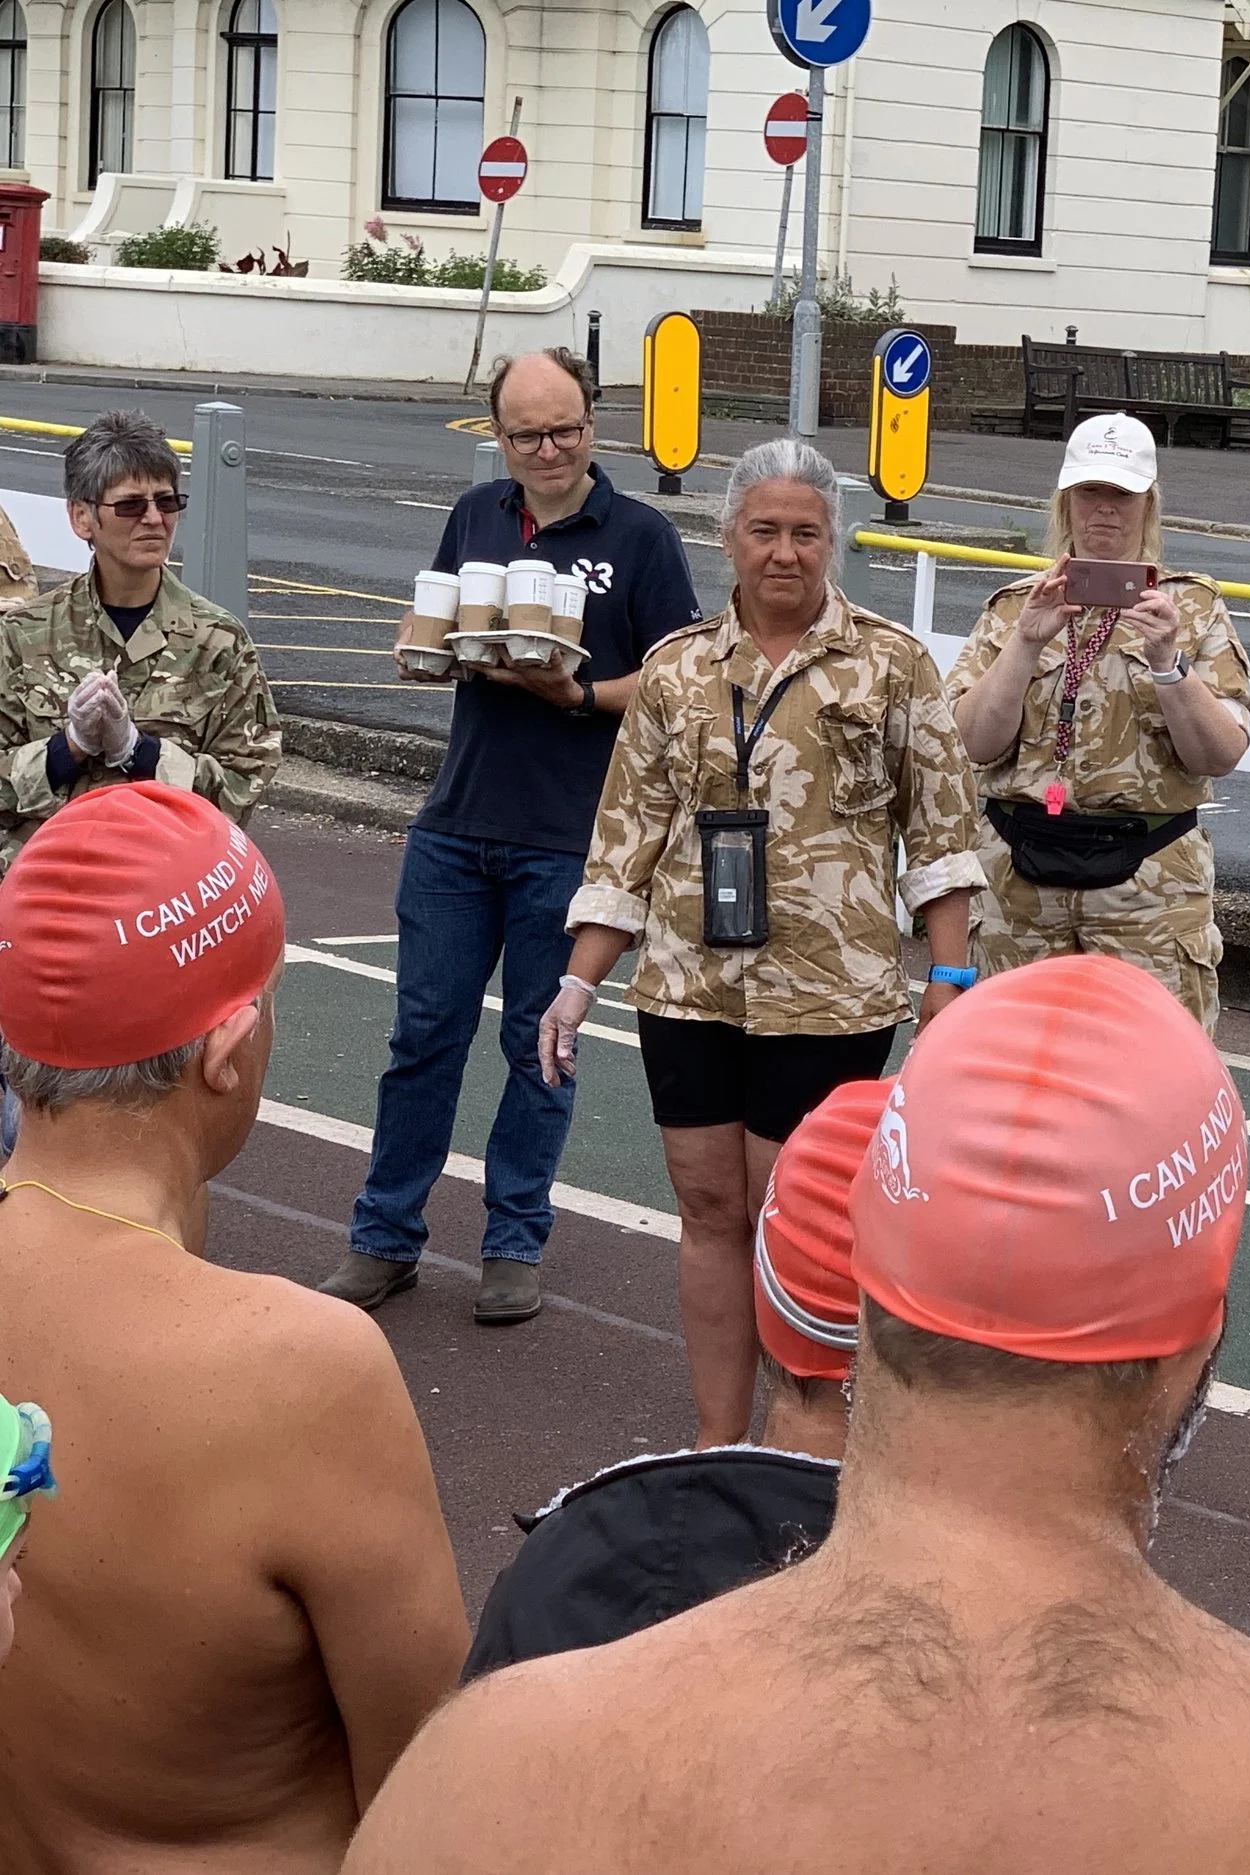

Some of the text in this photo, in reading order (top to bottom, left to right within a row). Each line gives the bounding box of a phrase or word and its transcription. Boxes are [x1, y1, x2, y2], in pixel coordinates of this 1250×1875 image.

[114, 919, 128, 945] I
[135, 891, 197, 938] CAN
[197, 860, 236, 909] AND
[226, 849, 243, 870] I
[169, 894, 252, 967] WATCH
[1100, 1188, 1118, 1223] I
[1129, 1140, 1197, 1209] CAN
[1200, 1087, 1233, 1164] AND
[1166, 1144, 1244, 1249] WATCH
